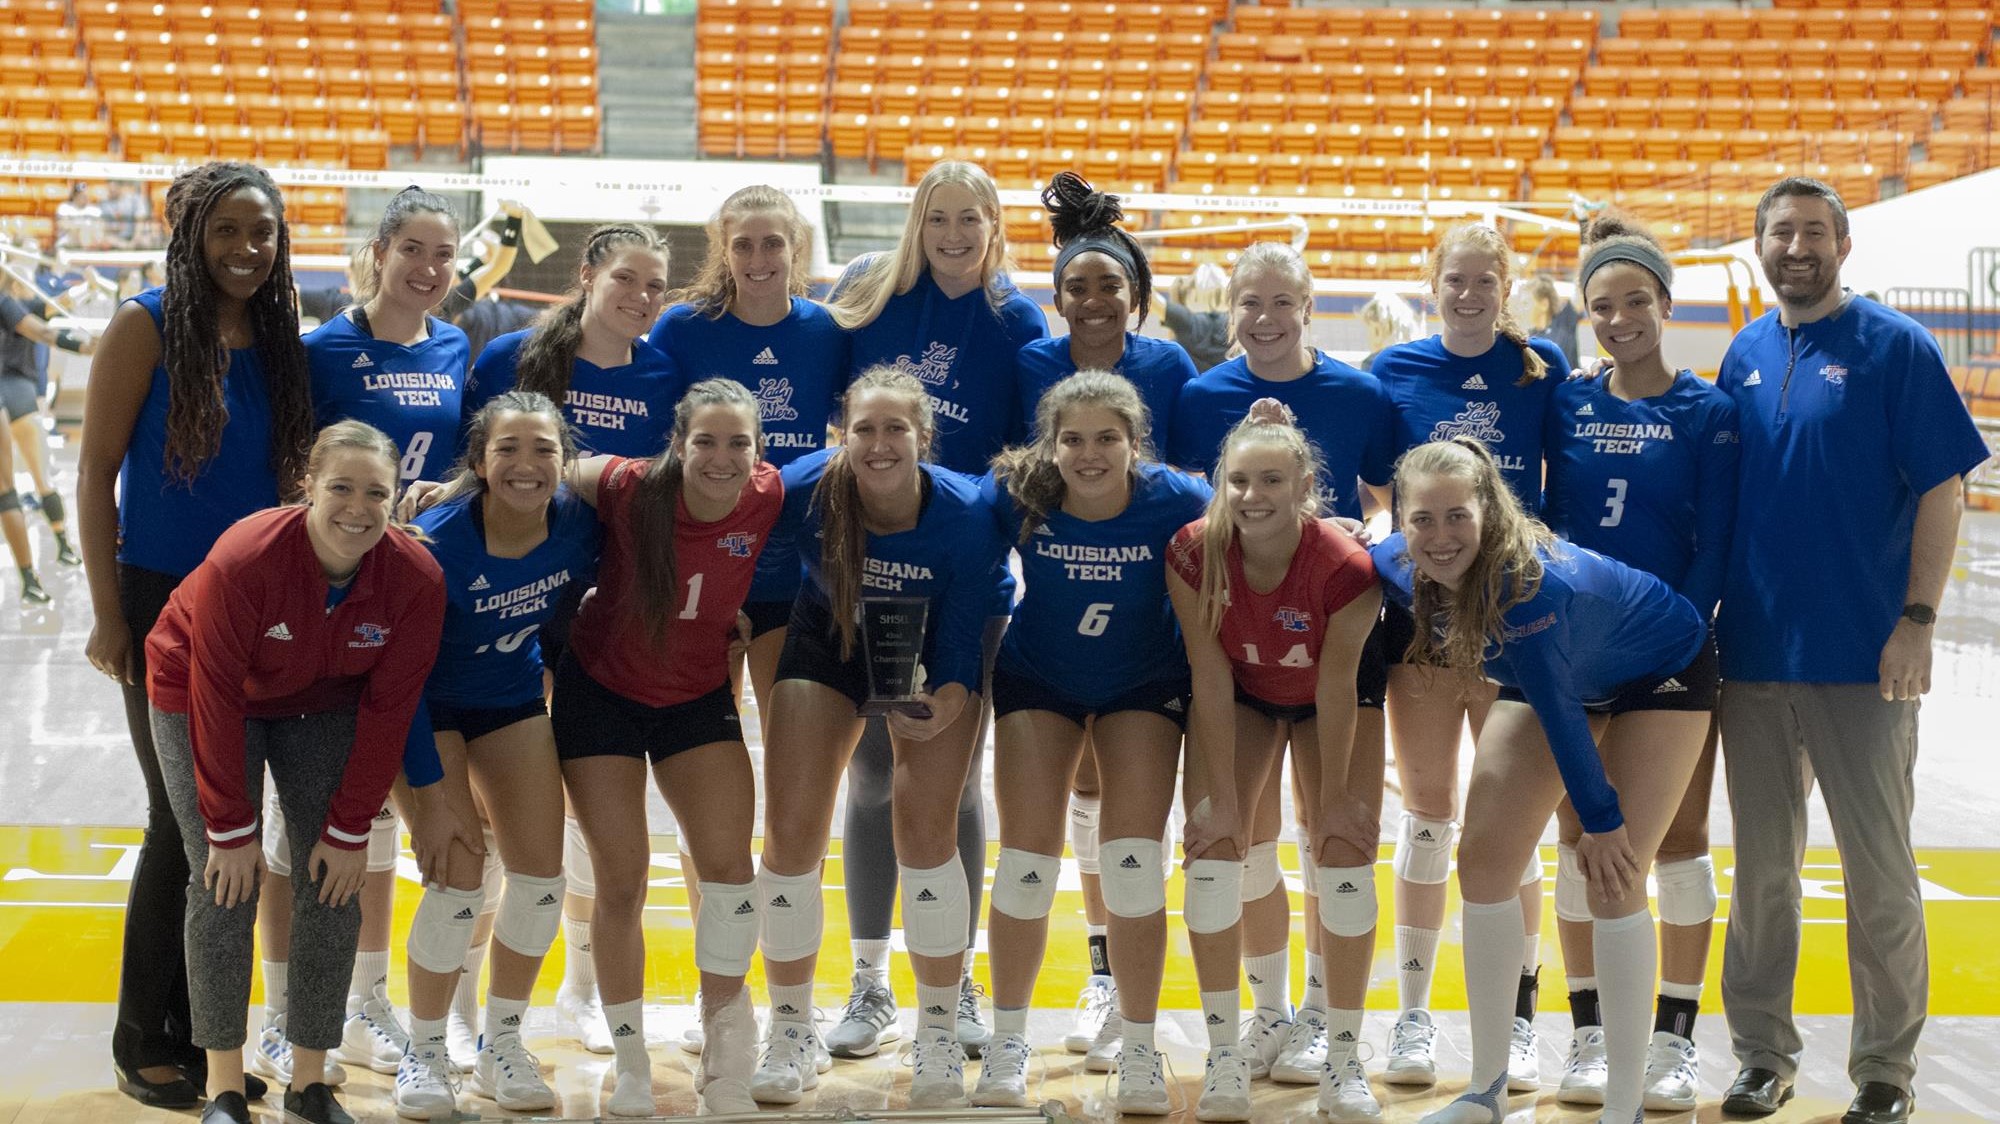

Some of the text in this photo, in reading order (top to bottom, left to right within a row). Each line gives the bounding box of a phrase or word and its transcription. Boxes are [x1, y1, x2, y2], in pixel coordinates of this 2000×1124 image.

[363, 372, 456, 391] LOUISIANA
[752, 377, 794, 405] Lady
[1461, 382, 1488, 390] adidas
[393, 391, 441, 406] TECH
[572, 408, 625, 430] TECH
[1456, 401, 1500, 428] Lady
[1574, 422, 1674, 440] LOUISIANA
[399, 431, 434, 480] 8
[1593, 440, 1644, 454] TECH
[1600, 479, 1628, 527] 3
[1036, 541, 1153, 562] LOUISIANA
[862, 573, 902, 591] ECH
[1064, 563, 1122, 581] TECH
[474, 568, 571, 613] LOUISIANA
[679, 573, 704, 620] 1
[498, 594, 548, 619] TECH
[1077, 603, 1114, 636] 6
[1653, 686, 1688, 694] adidas
